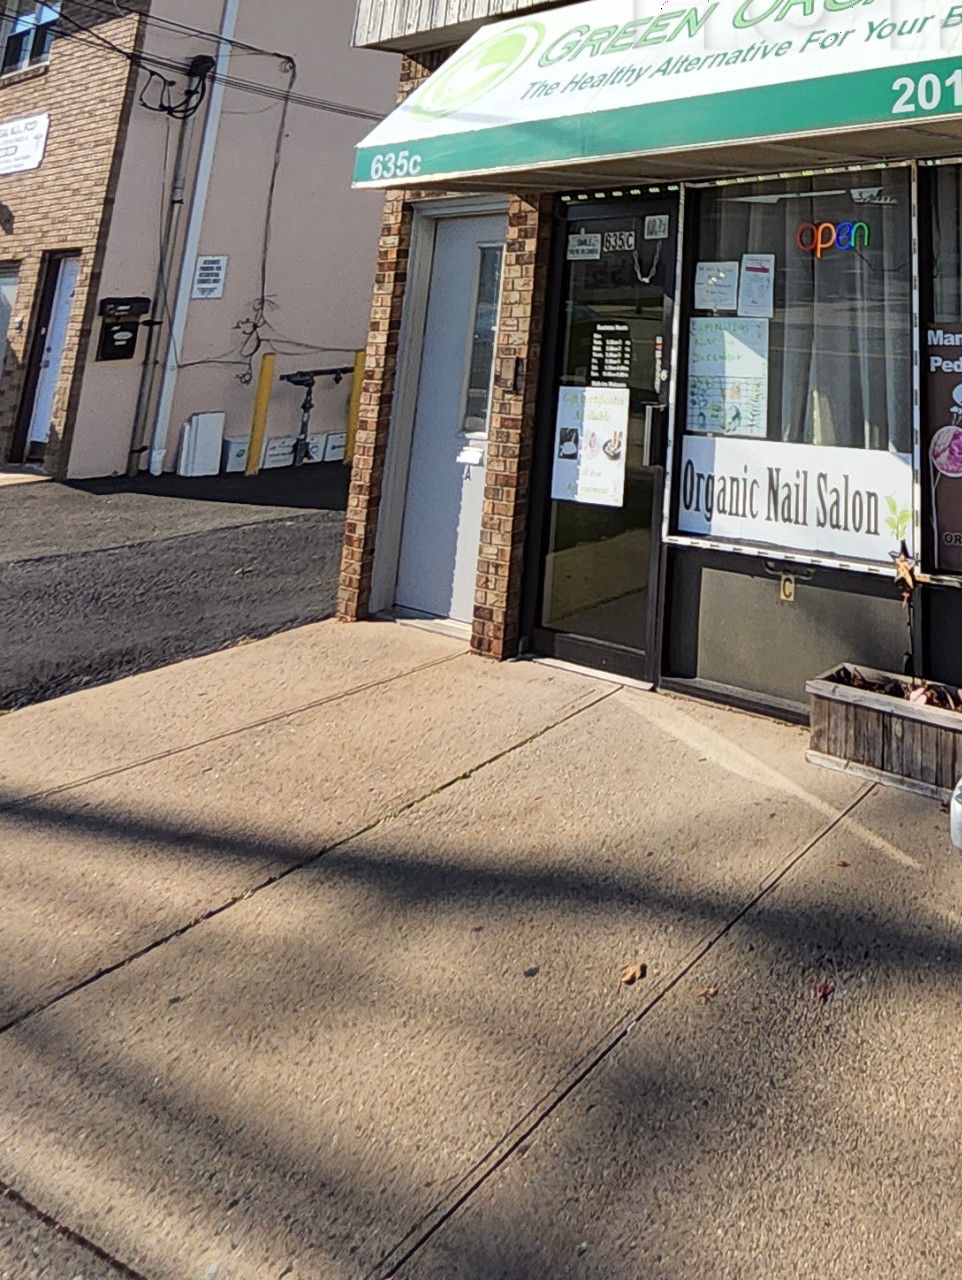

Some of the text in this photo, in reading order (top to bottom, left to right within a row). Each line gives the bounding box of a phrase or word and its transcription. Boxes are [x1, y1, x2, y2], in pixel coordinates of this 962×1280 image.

[520, 80, 559, 101] The
[561, 61, 652, 94] Healthy
[649, 37, 792, 80] Alternative
[799, 27, 856, 54] For
[864, 14, 936, 43] Your
[537, 1, 720, 68] GREEN
[370, 150, 422, 180] 635c
[683, 459, 880, 537] Organic Nail Salon
